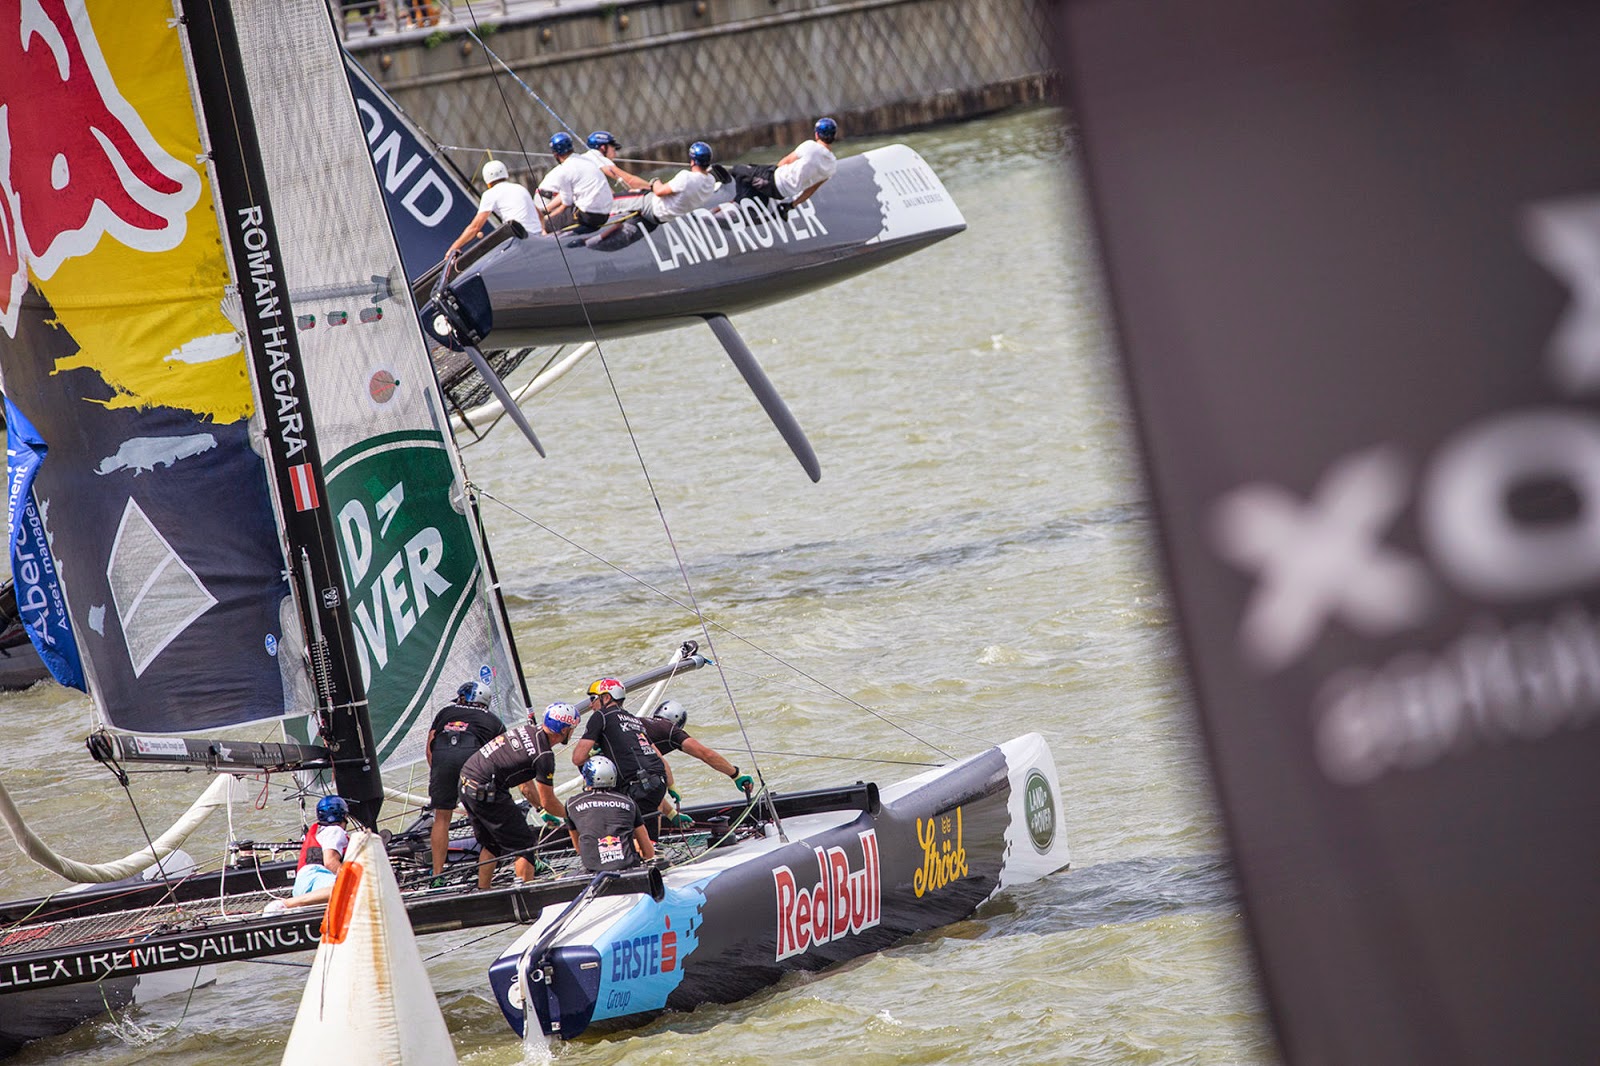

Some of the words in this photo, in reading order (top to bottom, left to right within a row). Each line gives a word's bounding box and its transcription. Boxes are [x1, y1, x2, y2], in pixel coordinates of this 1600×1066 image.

[638, 207, 730, 272] LAND
[718, 195, 829, 254] ROVER
[238, 205, 283, 318] ROMAN
[262, 326, 309, 459] HAGARA
[51, 580, 69, 631] Asset
[575, 800, 631, 812] WATERHOUSE
[913, 805, 969, 899] Ströck
[610, 934, 659, 983] ERSTE
[606, 989, 632, 1011] Group
